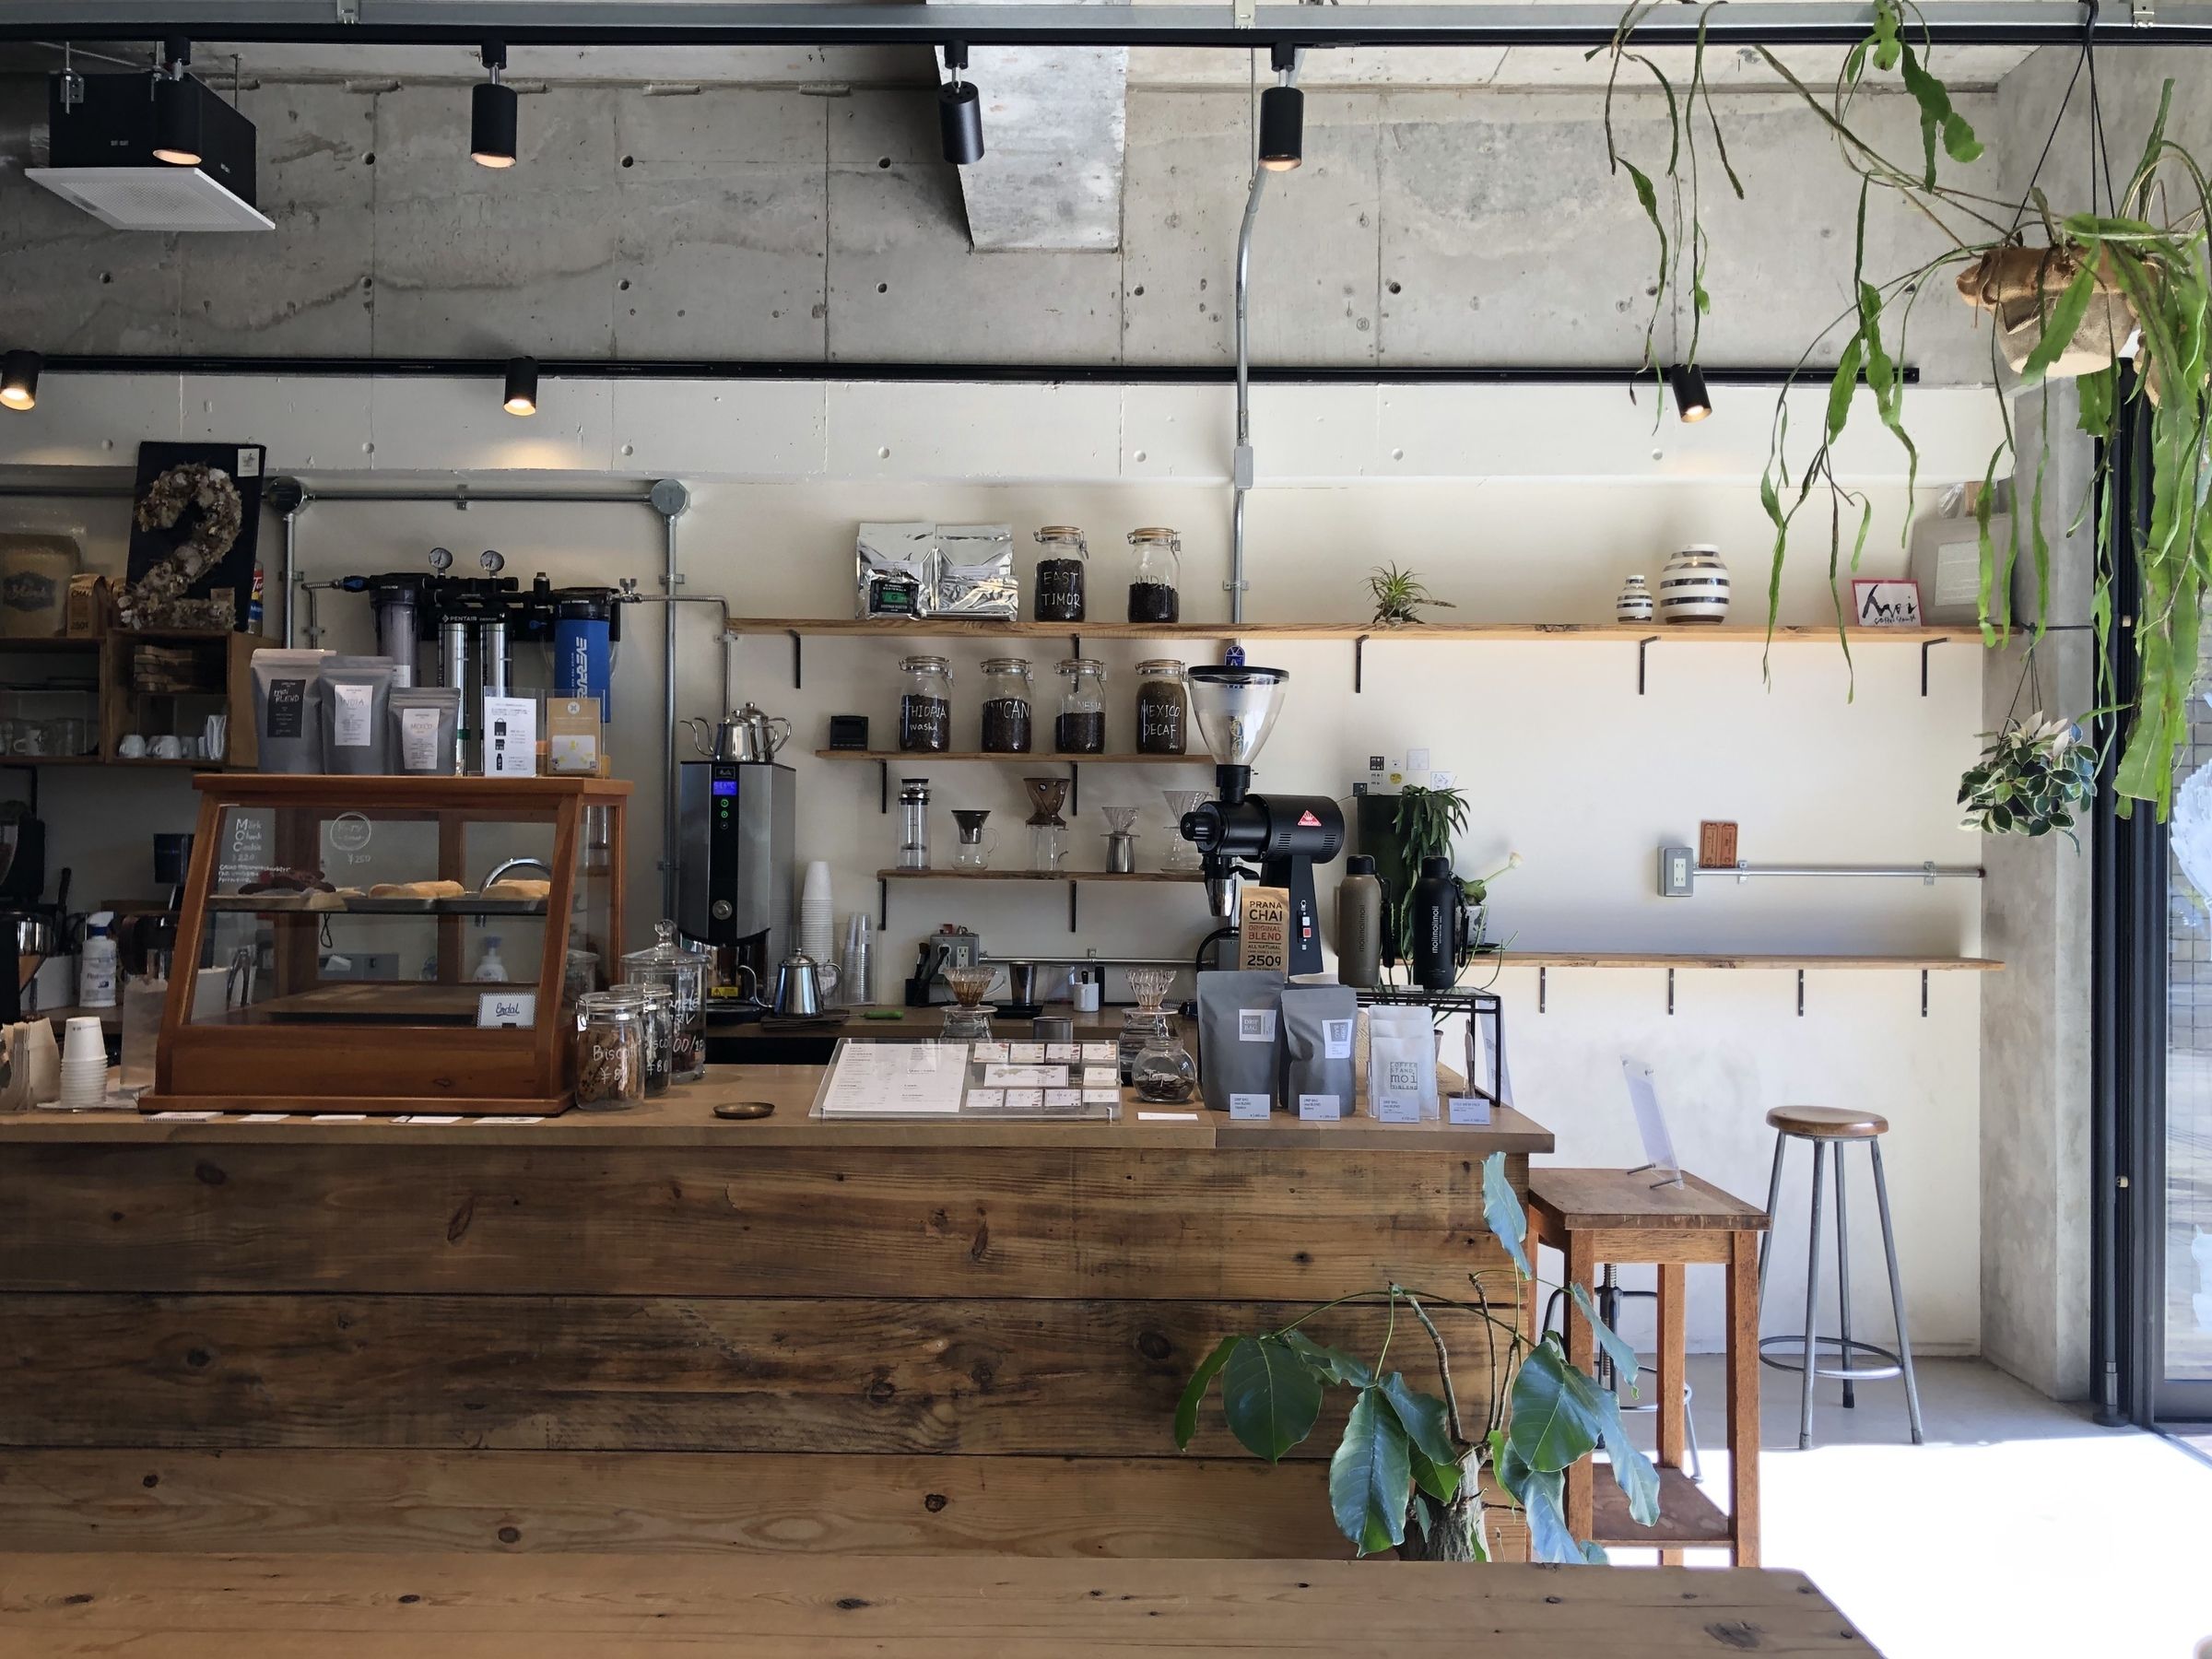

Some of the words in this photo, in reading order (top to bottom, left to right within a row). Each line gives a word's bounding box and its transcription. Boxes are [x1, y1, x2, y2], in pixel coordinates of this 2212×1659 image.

[1043, 571, 1078, 586] EAST
[1041, 593, 1081, 607] TIMOR
[1140, 703, 1181, 718] MEXICO
[1144, 724, 1177, 739] DECAF
[1250, 900, 1282, 910] PRANA
[1249, 909, 1282, 922] CHAI
[1248, 924, 1282, 933] ORIGINAL
[1248, 932, 1282, 941] BLEND
[1247, 955, 1281, 967] 250g
[1390, 1072, 1418, 1084] moi
